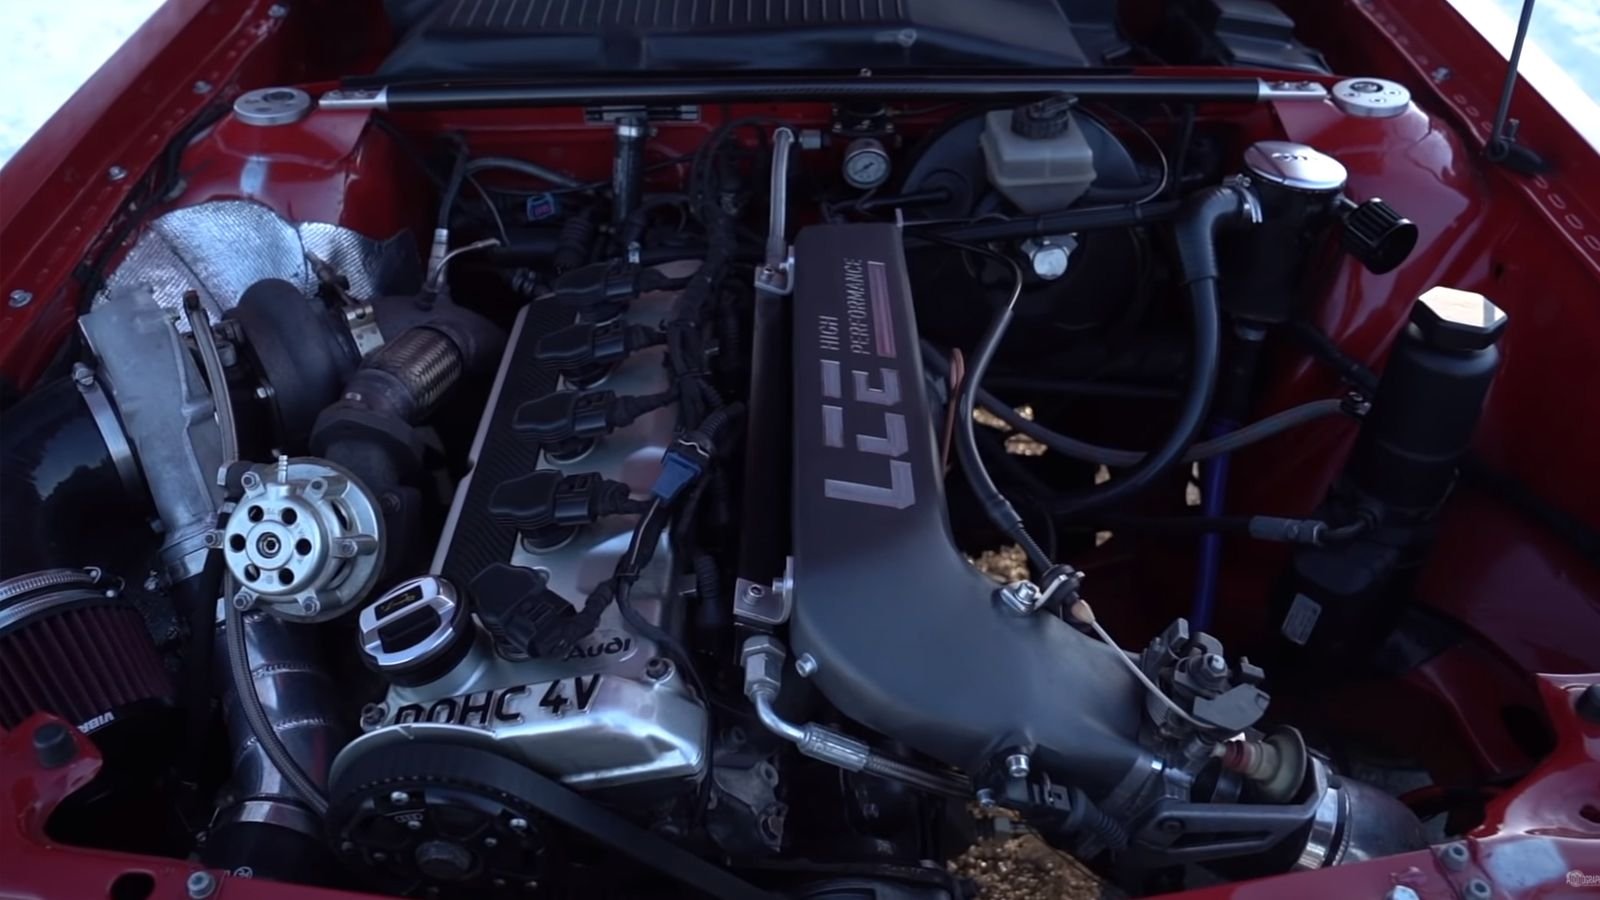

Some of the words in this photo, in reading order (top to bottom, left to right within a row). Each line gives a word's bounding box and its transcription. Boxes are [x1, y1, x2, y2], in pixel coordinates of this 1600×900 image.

[844, 257, 871, 355] PERFORMANCE
[818, 315, 840, 351] HIGH
[538, 673, 604, 714] 4V
